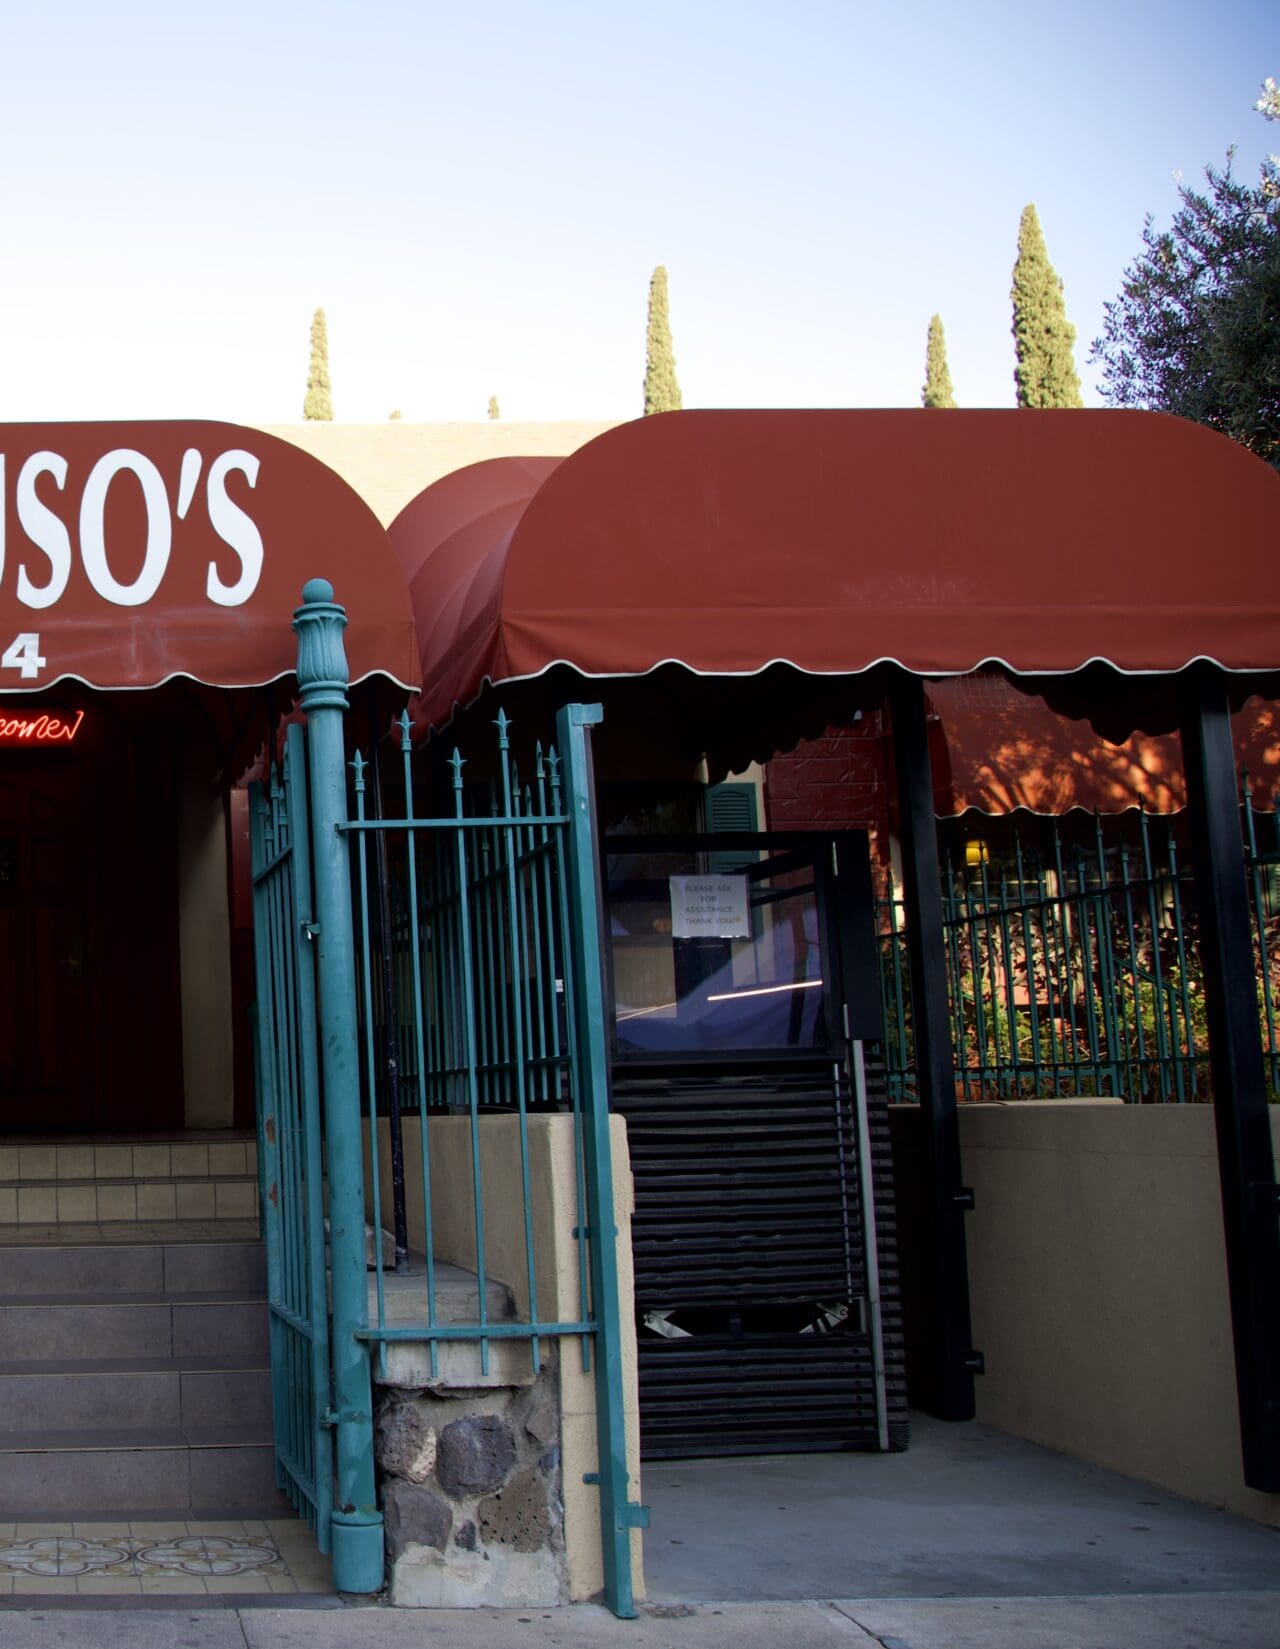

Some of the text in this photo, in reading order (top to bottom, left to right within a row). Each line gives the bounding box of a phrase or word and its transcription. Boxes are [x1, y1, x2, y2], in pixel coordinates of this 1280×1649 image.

[685, 884, 732, 892] PLEASE ASK
[700, 895, 717, 903] FOR
[685, 917, 712, 925] THANK
